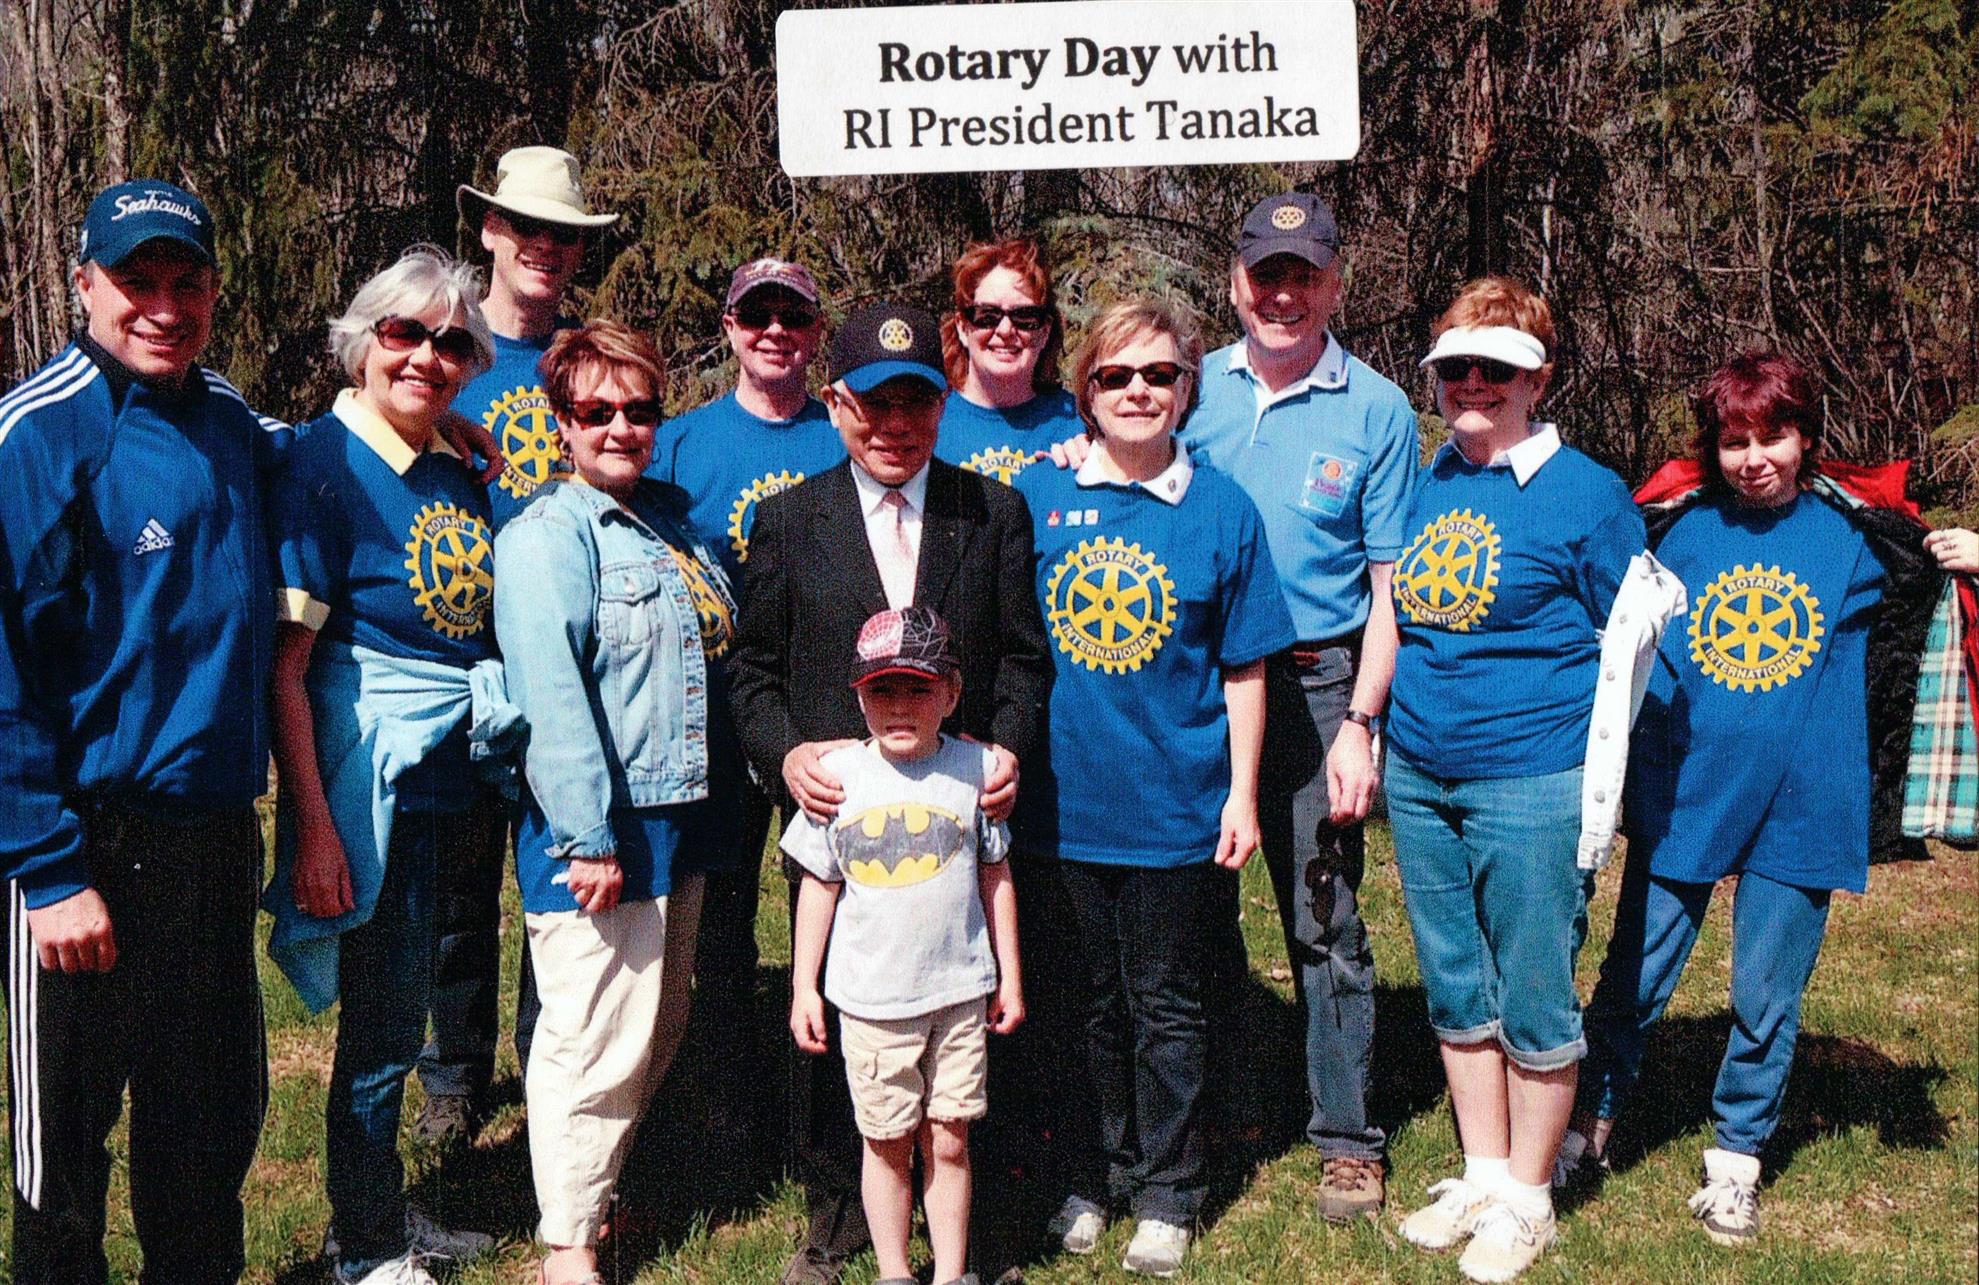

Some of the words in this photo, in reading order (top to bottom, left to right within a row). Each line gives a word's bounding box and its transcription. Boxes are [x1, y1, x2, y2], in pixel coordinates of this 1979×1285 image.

[111, 190, 201, 225] Seahawks
[1438, 521, 1483, 541] ROTARY
[1086, 550, 1143, 570] ROTARY
[1726, 576, 1785, 593] ROTARY
[1400, 586, 1478, 624] INTERNATIONAL
[1061, 622, 1155, 660] INTERNATIONAL
[1705, 647, 1801, 679] INTERNATIONAL
